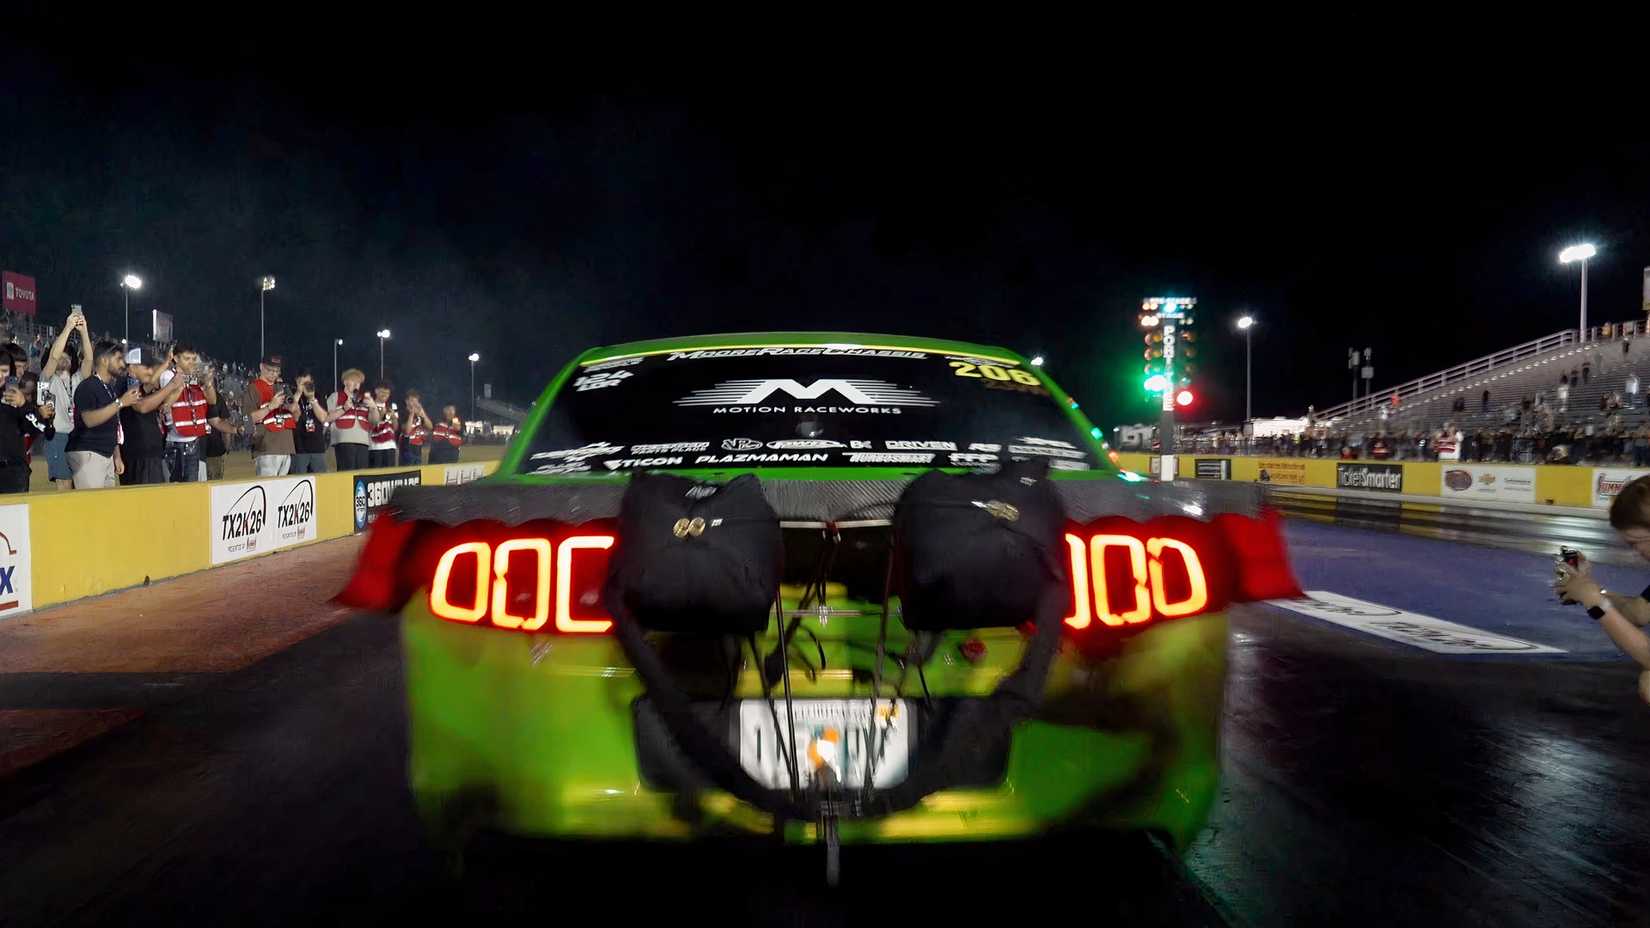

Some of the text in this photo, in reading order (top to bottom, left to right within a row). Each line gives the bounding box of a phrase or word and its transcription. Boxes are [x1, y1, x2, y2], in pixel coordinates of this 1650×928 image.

[949, 361, 1041, 386] 206
[712, 406, 902, 415] MOTION RACEWORKS
[621, 457, 684, 468] TICON
[694, 453, 829, 464] PLAZMAMAN
[277, 501, 310, 529] TX2K26
[222, 510, 262, 540] TX2K26
